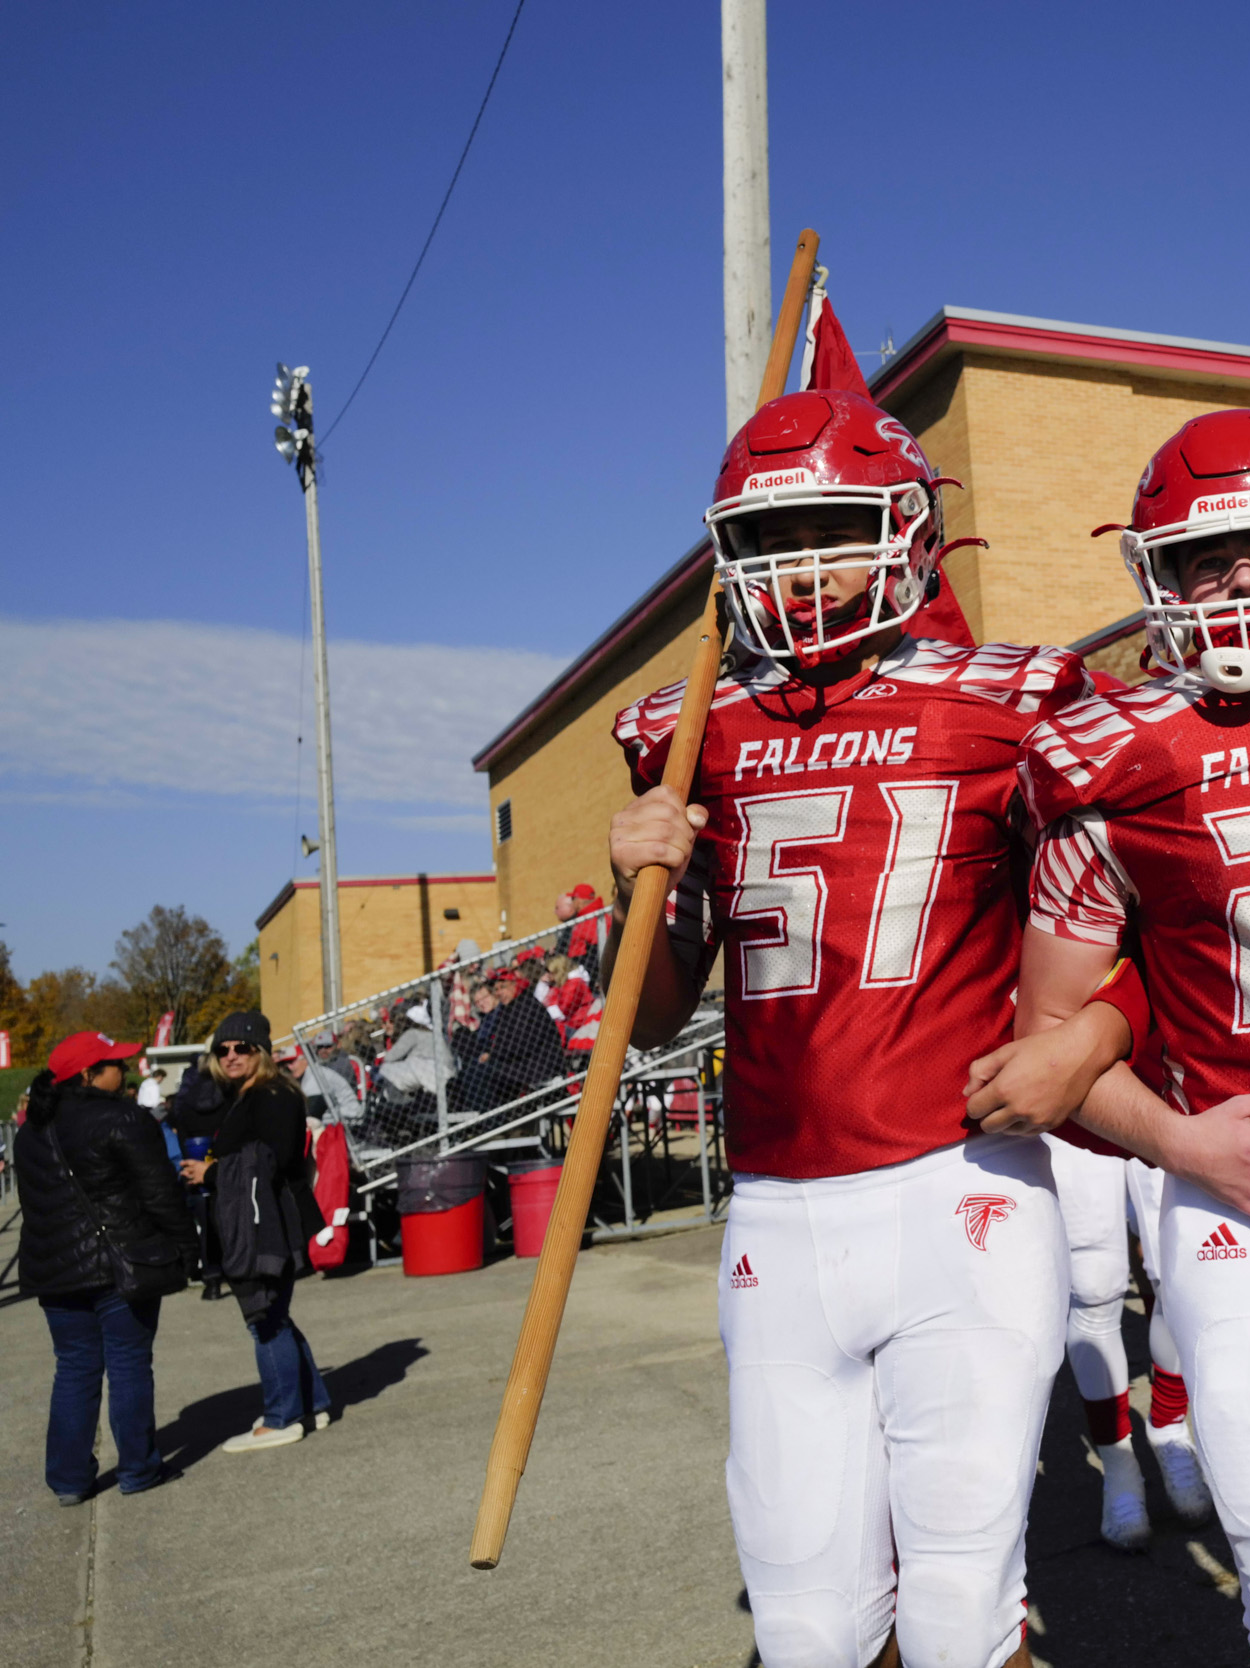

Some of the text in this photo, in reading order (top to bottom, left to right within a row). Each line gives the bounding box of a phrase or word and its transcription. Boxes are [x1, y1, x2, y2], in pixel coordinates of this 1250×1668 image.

[749, 471, 805, 490] Riddell
[735, 726, 917, 781] FALCONS
[729, 780, 960, 1000] 51
[1196, 1245, 1247, 1261] adidas
